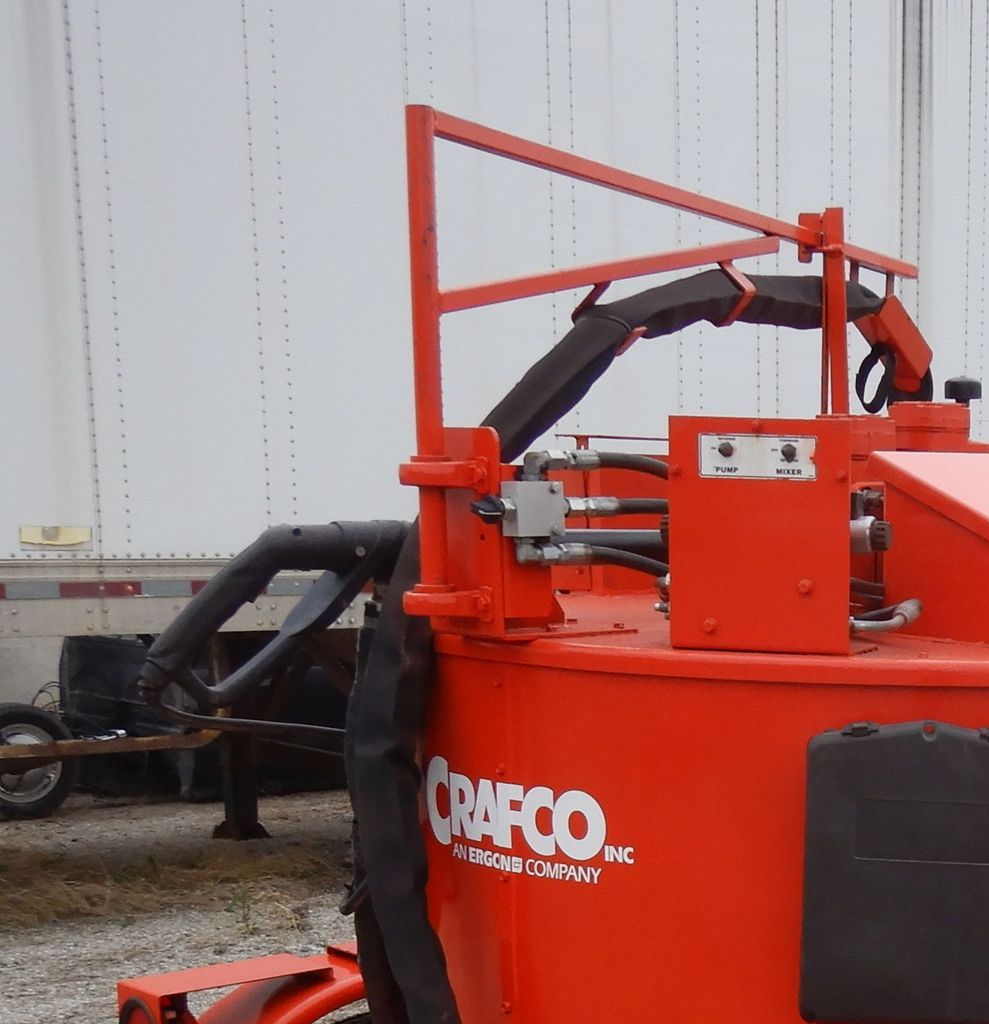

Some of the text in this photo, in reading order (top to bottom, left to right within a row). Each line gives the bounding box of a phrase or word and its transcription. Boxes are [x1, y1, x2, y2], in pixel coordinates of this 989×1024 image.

[426, 755, 635, 864] CRAFCO INC
[453, 842, 467, 860] AN
[525, 858, 602, 884] COMPANY
